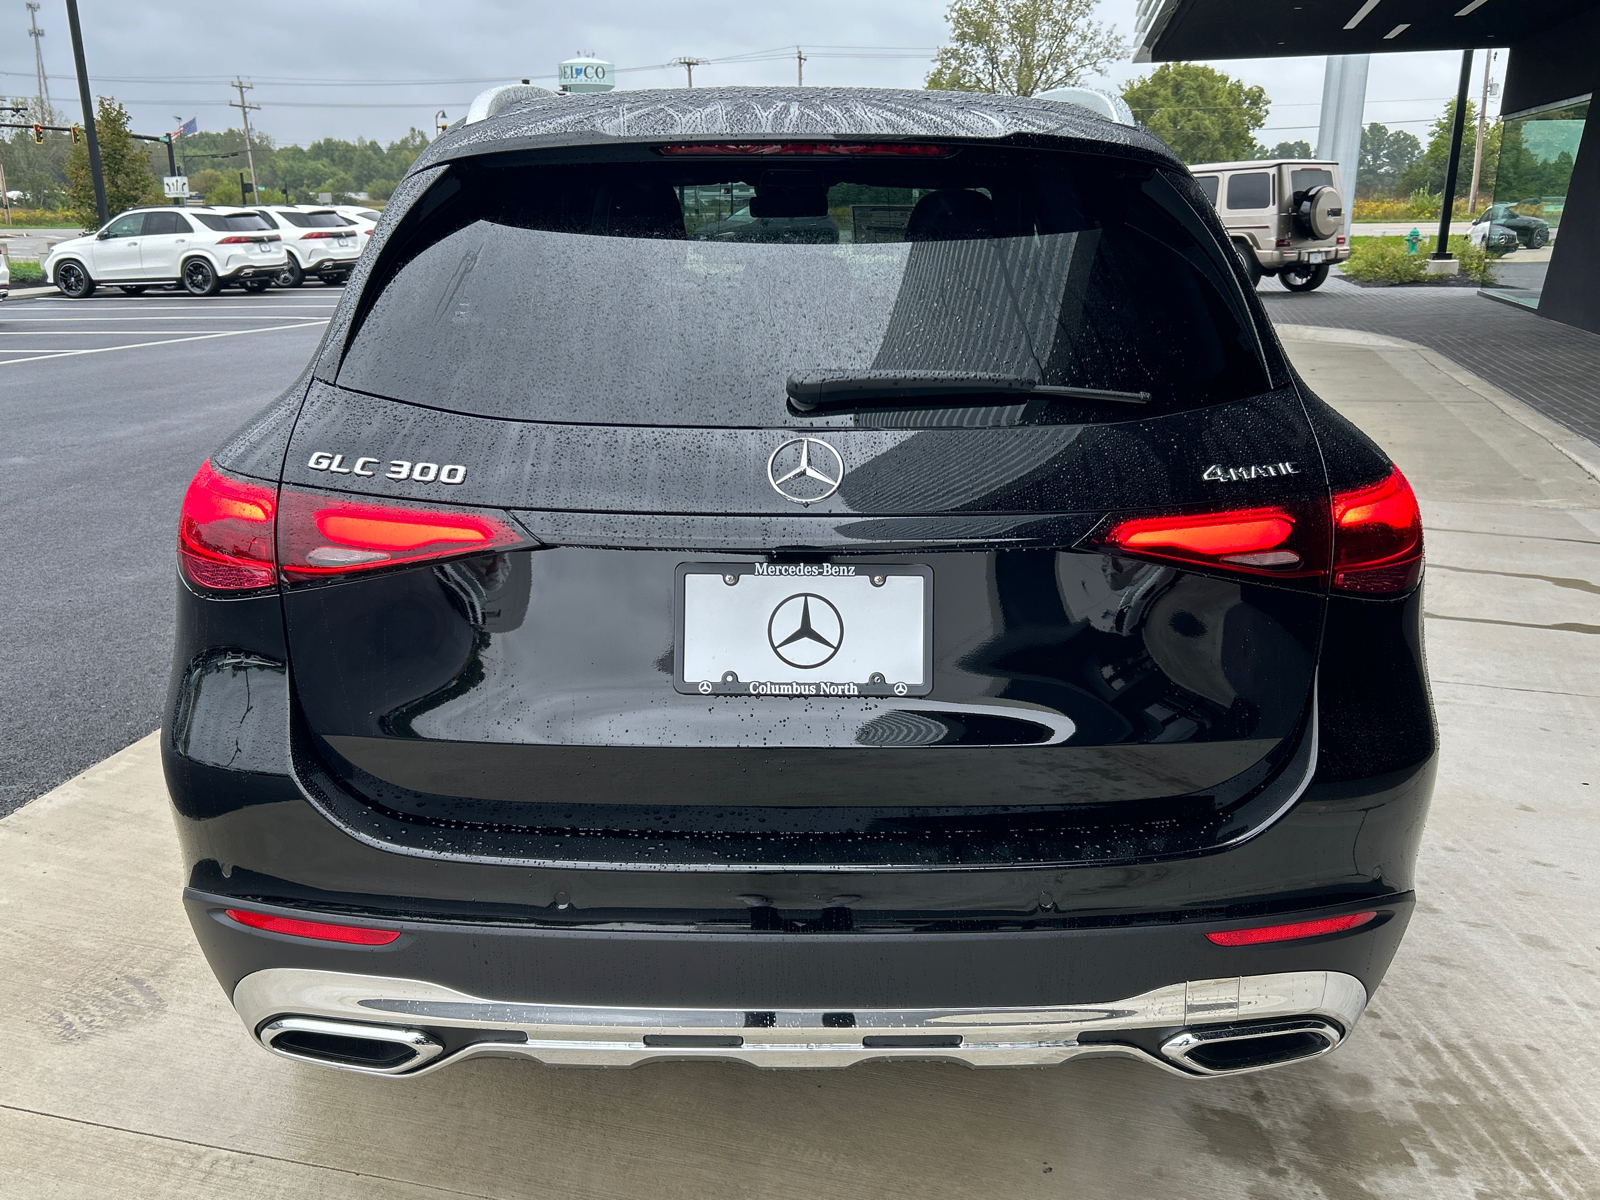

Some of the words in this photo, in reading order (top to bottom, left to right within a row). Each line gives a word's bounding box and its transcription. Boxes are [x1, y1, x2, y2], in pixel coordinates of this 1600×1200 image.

[307, 451, 380, 478] GLC
[385, 460, 467, 485] 300
[754, 562, 856, 577] Mercedes-Benz
[749, 682, 818, 696] Columbus
[819, 682, 858, 696] North
